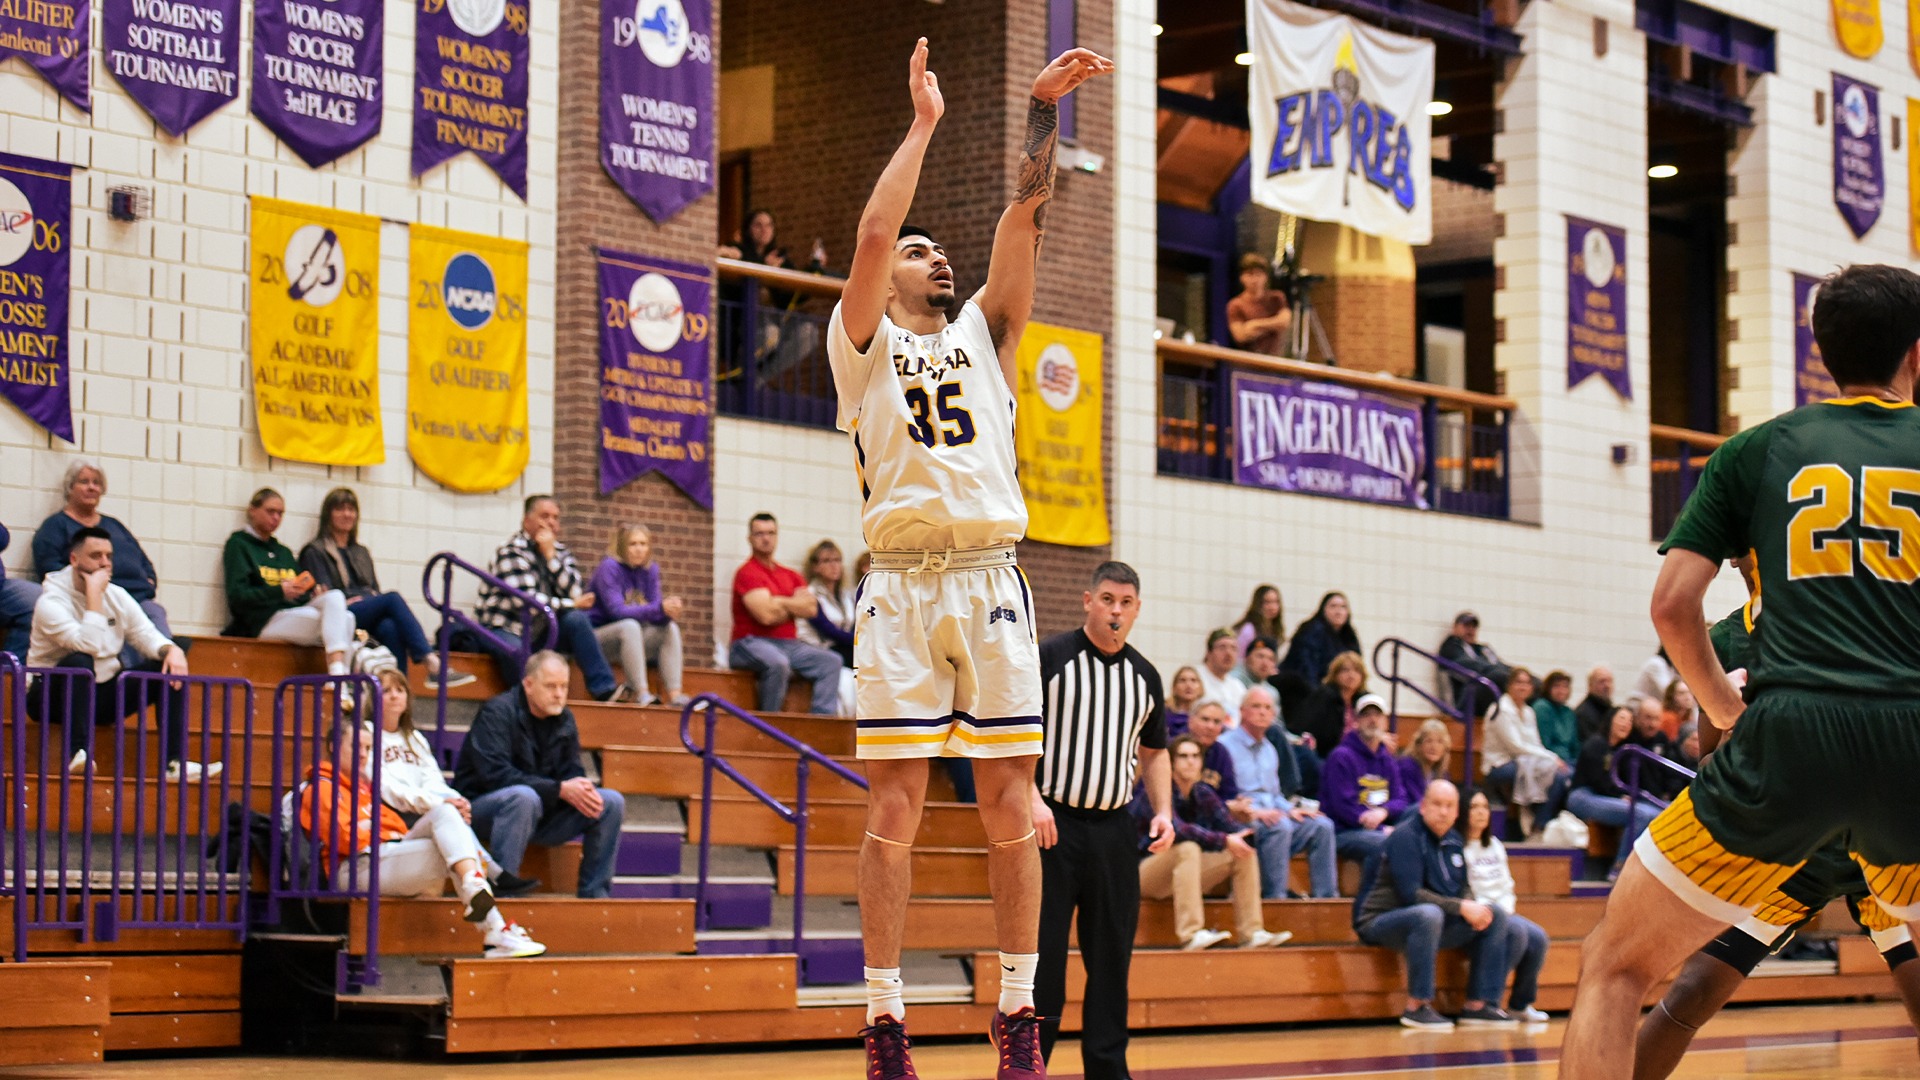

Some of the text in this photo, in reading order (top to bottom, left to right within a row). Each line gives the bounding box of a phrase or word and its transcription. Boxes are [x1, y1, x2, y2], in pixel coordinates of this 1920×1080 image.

[132, 0, 223, 34] WOMEN'S
[284, 0, 365, 41] WOMEN'S
[504, 5, 528, 35] 98
[0, 24, 52, 57] anleoni
[128, 24, 225, 64] SOFTBALL
[287, 32, 356, 69] SOCCER
[436, 35, 512, 73] WOMEN'S
[613, 17, 712, 65] 19 98
[112, 50, 235, 97] TOURNAMENT
[264, 54, 378, 102] TOURNAMENT
[440, 66, 504, 100] SOCCER
[420, 87, 526, 132] TOURNAMENT
[621, 94, 697, 130] WOMEN'S
[436, 119, 508, 155] FINALIST
[630, 121, 690, 154] TENNIS
[609, 143, 709, 183] TOURNAMENT
[33, 219, 61, 254] 06
[260, 253, 373, 299] 20 08
[416, 279, 524, 323] 20 NCAA 08
[604, 297, 628, 330] 20
[683, 311, 708, 343] 09
[293, 314, 334, 339] GOLF
[447, 337, 486, 361] GOLF
[430, 362, 512, 393] QUALIFIER
[904, 380, 978, 450] 35
[1238, 389, 1341, 467] FINGER
[1786, 463, 1920, 585] 25
